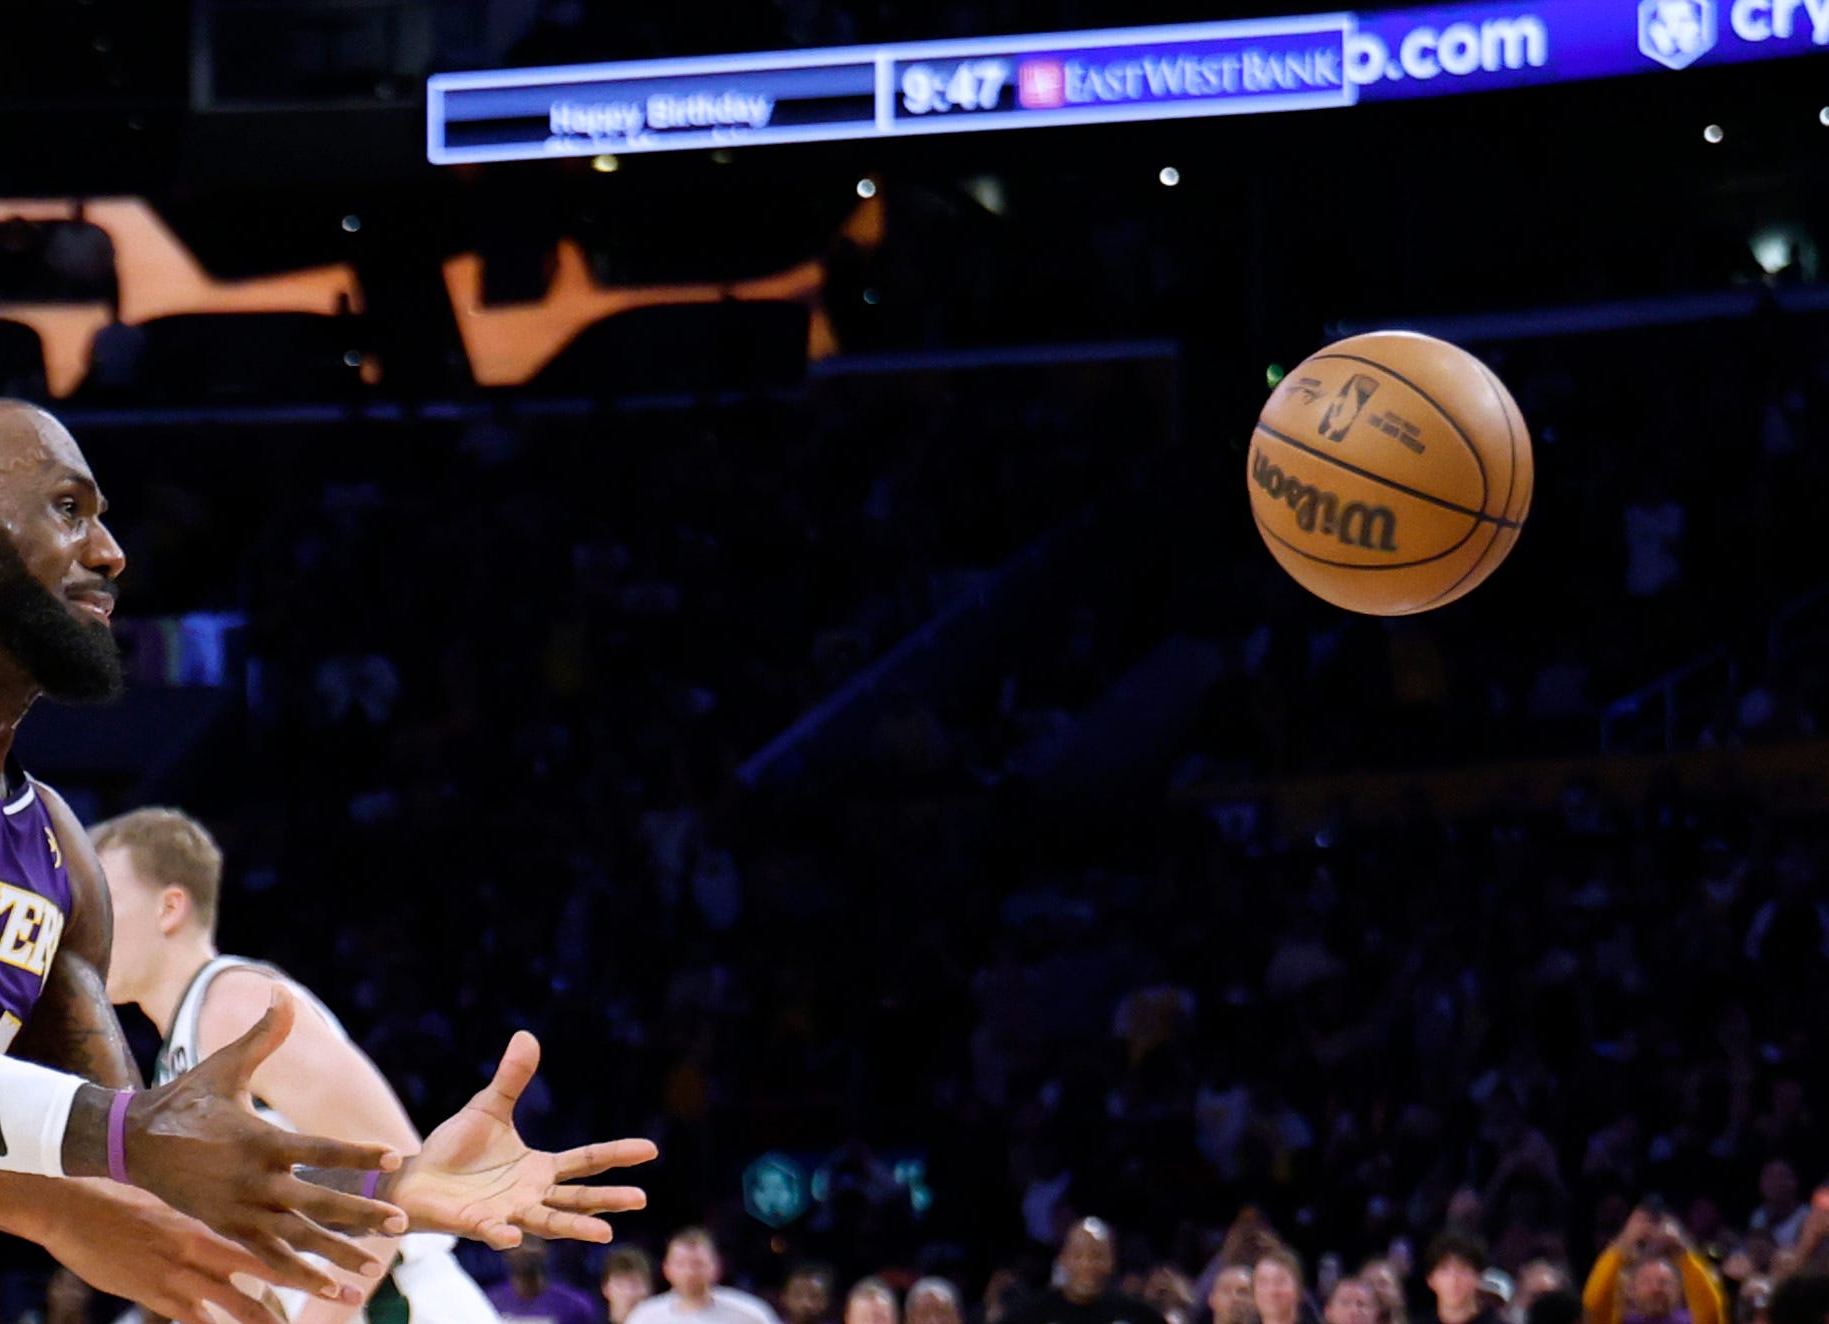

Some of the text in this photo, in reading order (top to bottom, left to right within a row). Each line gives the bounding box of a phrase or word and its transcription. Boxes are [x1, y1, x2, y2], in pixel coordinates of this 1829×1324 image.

[646, 92, 774, 129] Birthday
[902, 59, 1008, 114] 9:47
[1252, 446, 1399, 553] Wilson
